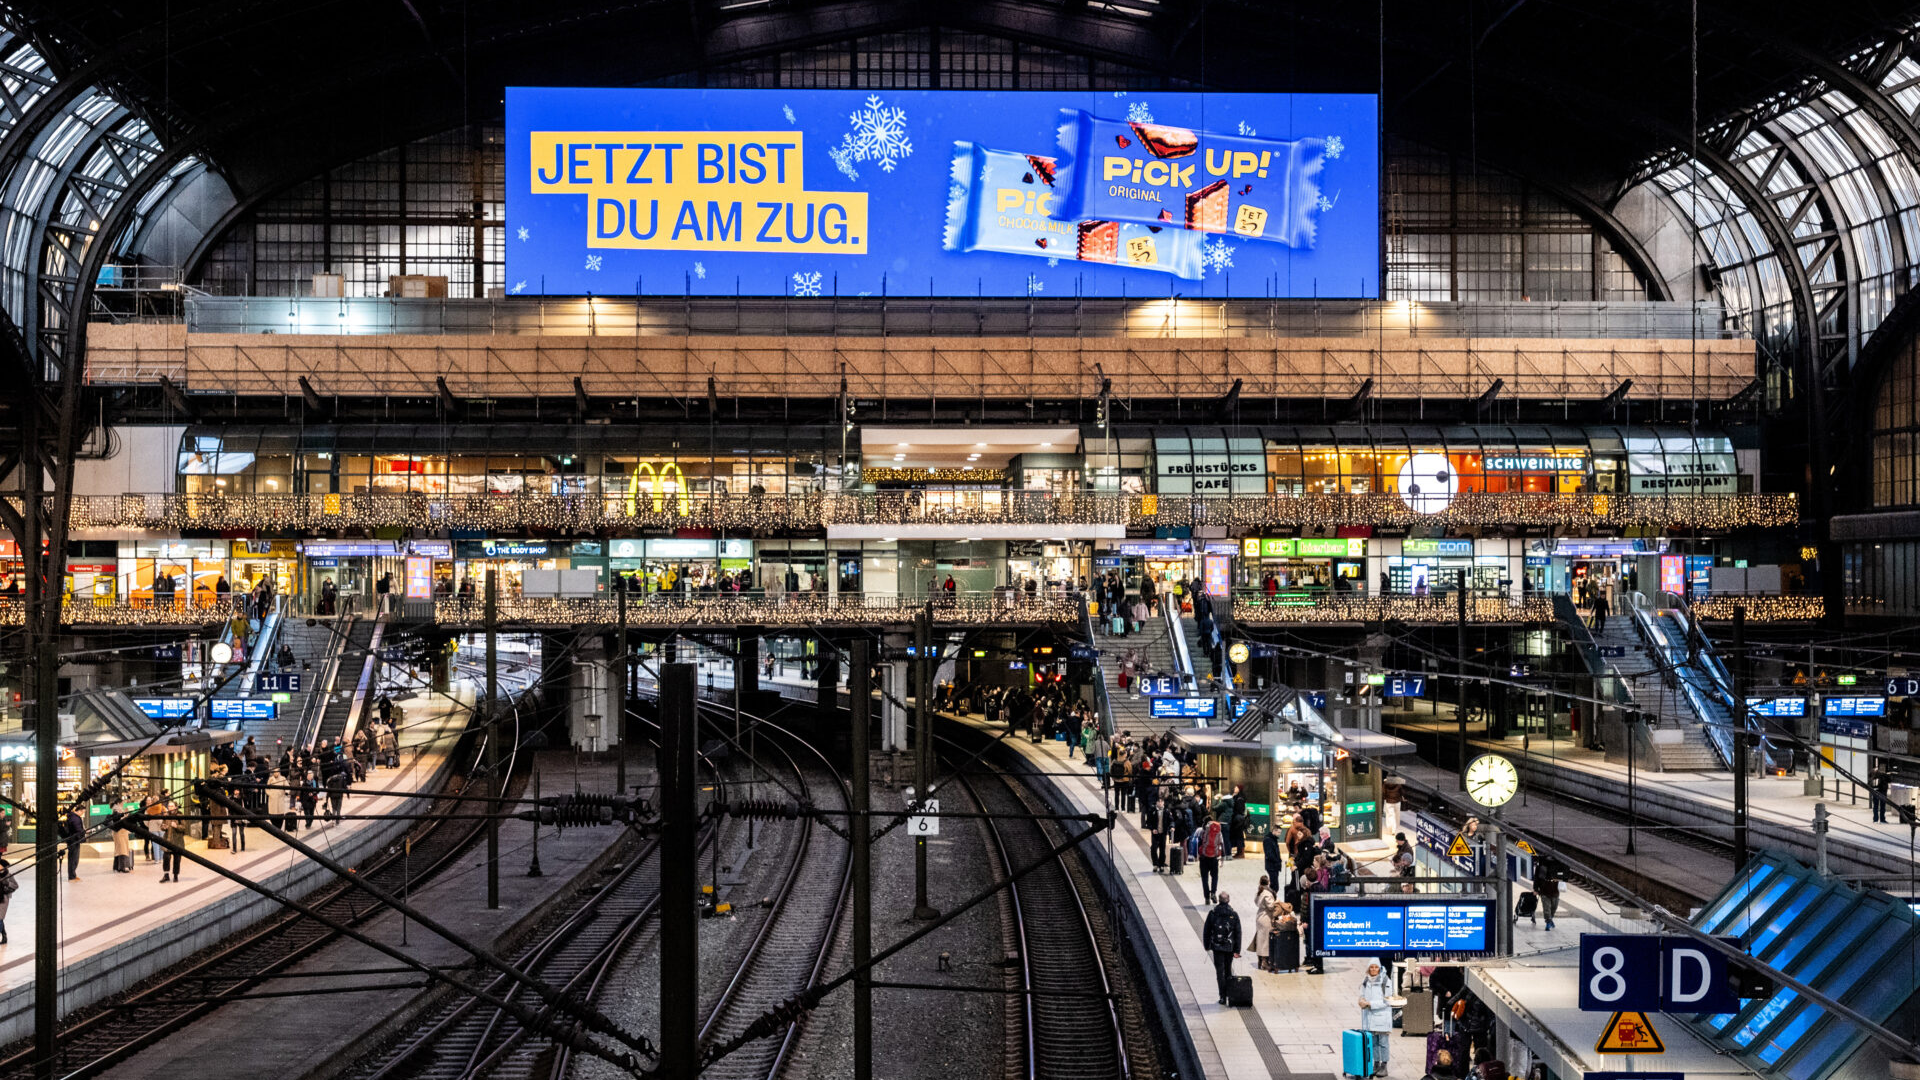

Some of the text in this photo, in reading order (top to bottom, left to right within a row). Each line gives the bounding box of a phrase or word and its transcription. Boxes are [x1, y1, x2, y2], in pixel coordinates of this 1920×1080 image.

[537, 142, 796, 185] JETZT BIST
[1205, 148, 1272, 179] UP!
[1109, 185, 1163, 203] ORIGINAL
[1242, 207, 1263, 220] TET
[596, 198, 861, 245] DU AM ZUG.
[1168, 462, 1258, 474] FRÜHSTÜCKS
[1195, 477, 1230, 489] CAFÉ
[1641, 477, 1730, 489] RESTAURANT
[261, 676, 299, 690] 11 E
[1141, 677, 1171, 693] 8 E
[1392, 679, 1423, 694] E 7
[1887, 679, 1919, 694] 6 D
[1312, 697, 1319, 707] 7
[918, 817, 928, 832] 6
[1327, 912, 1347, 920] 08:53
[1327, 921, 1371, 929] Koebenhavn H
[1589, 946, 1712, 1003] 8 D
